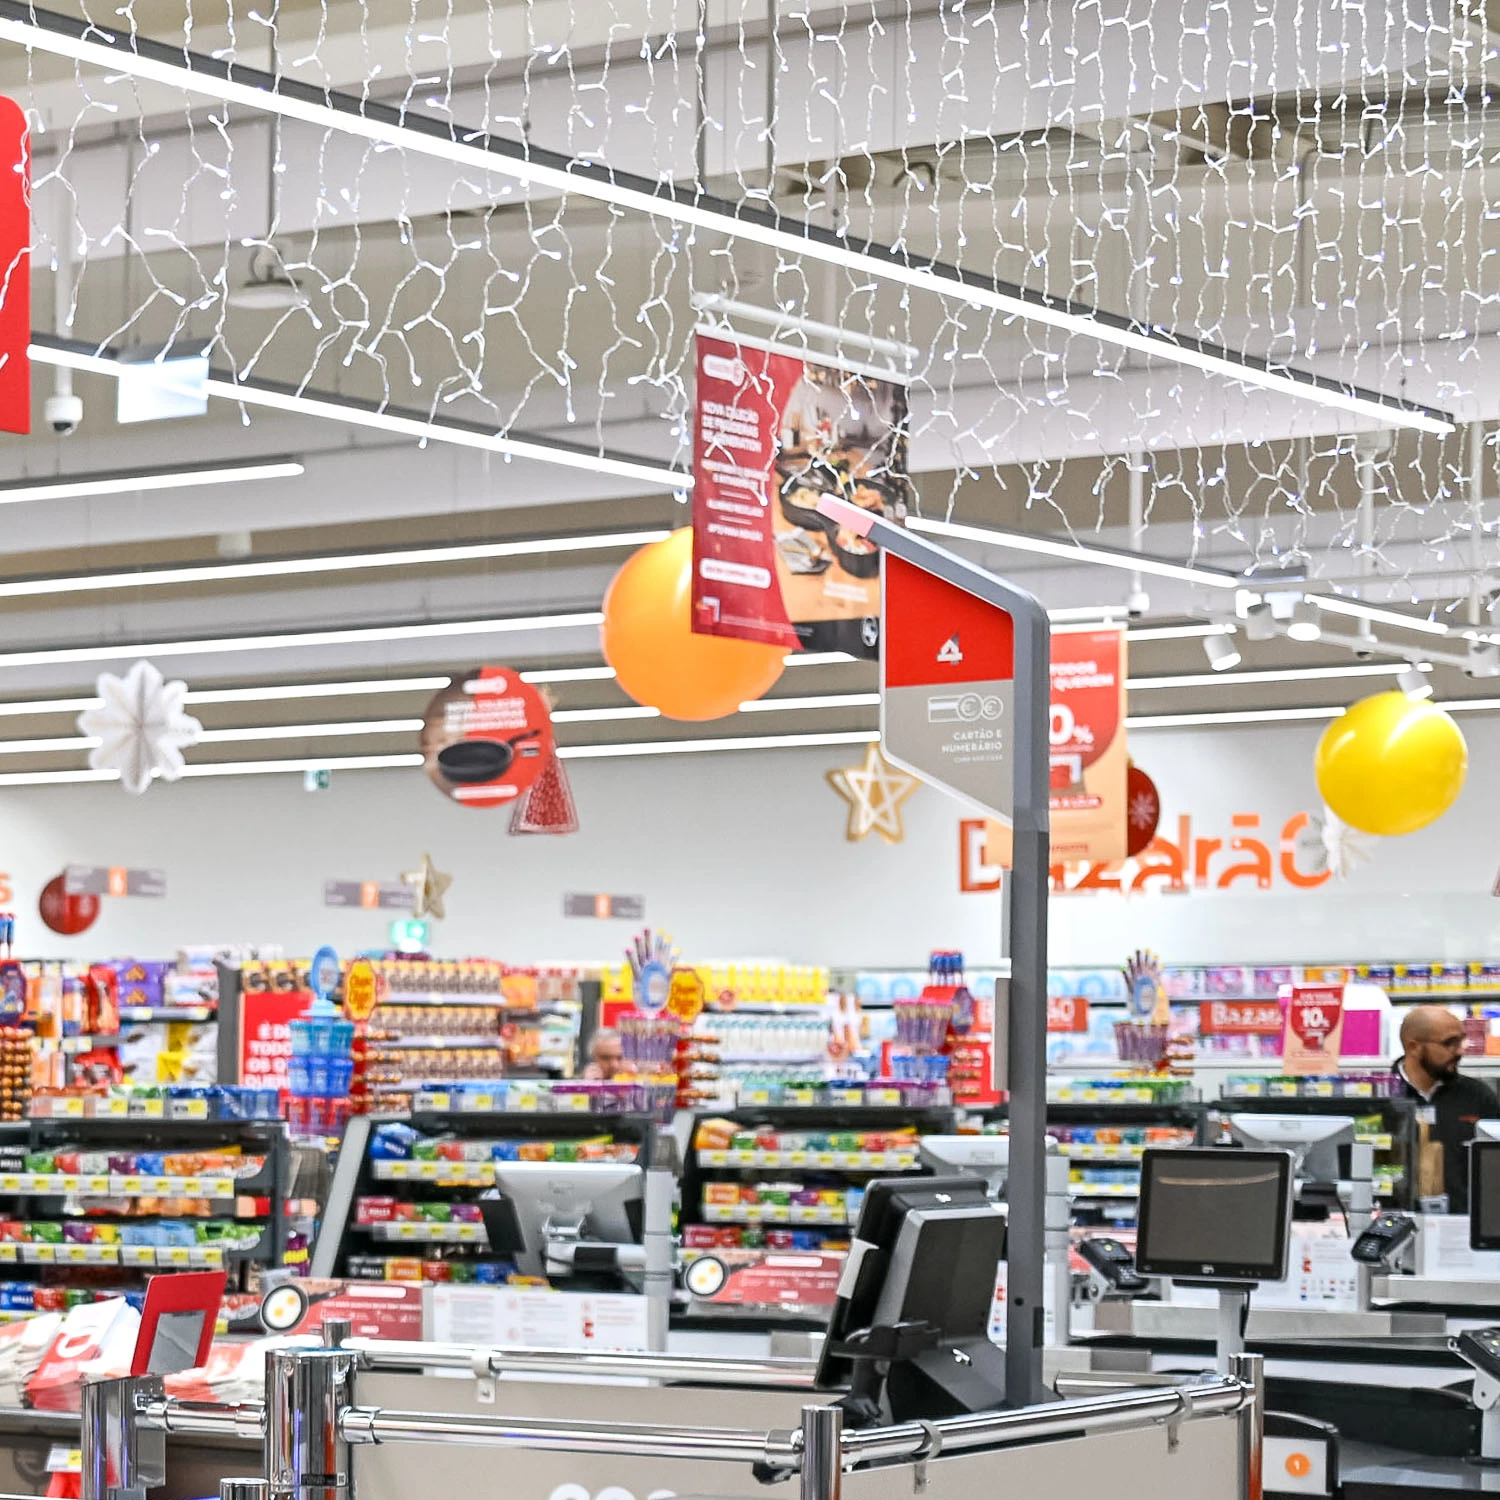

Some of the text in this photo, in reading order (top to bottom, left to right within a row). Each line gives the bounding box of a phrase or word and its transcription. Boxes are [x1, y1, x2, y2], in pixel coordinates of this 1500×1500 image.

[937, 632, 963, 665] 4
[953, 728, 993, 741] CARTÃO
[941, 740, 1002, 753] NUMERÁRIO
